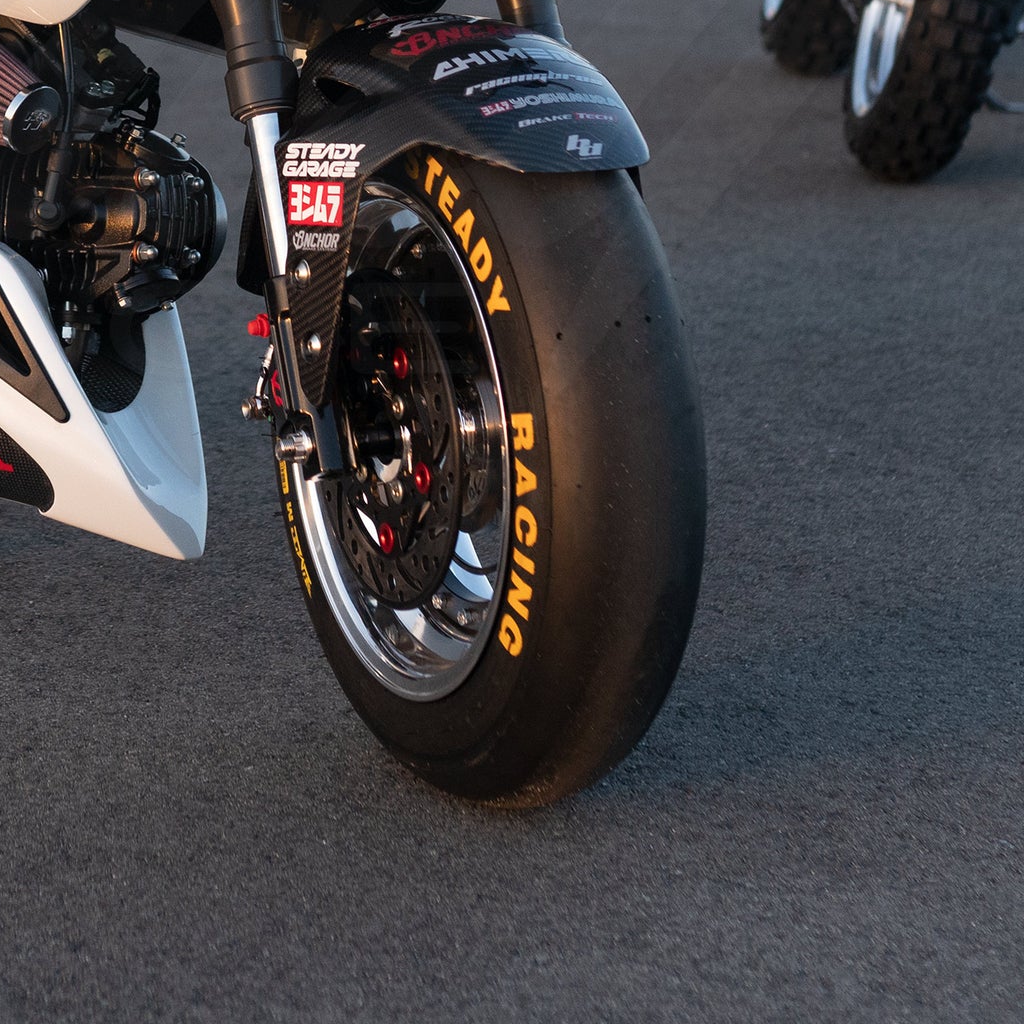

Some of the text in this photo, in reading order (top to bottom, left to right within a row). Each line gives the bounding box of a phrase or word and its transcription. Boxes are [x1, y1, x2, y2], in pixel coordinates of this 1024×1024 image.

[285, 143, 366, 160] STEADY
[282, 161, 360, 178] GARAGE
[292, 229, 340, 251] ANCHOR
[405, 148, 538, 657] STEADY RACING
